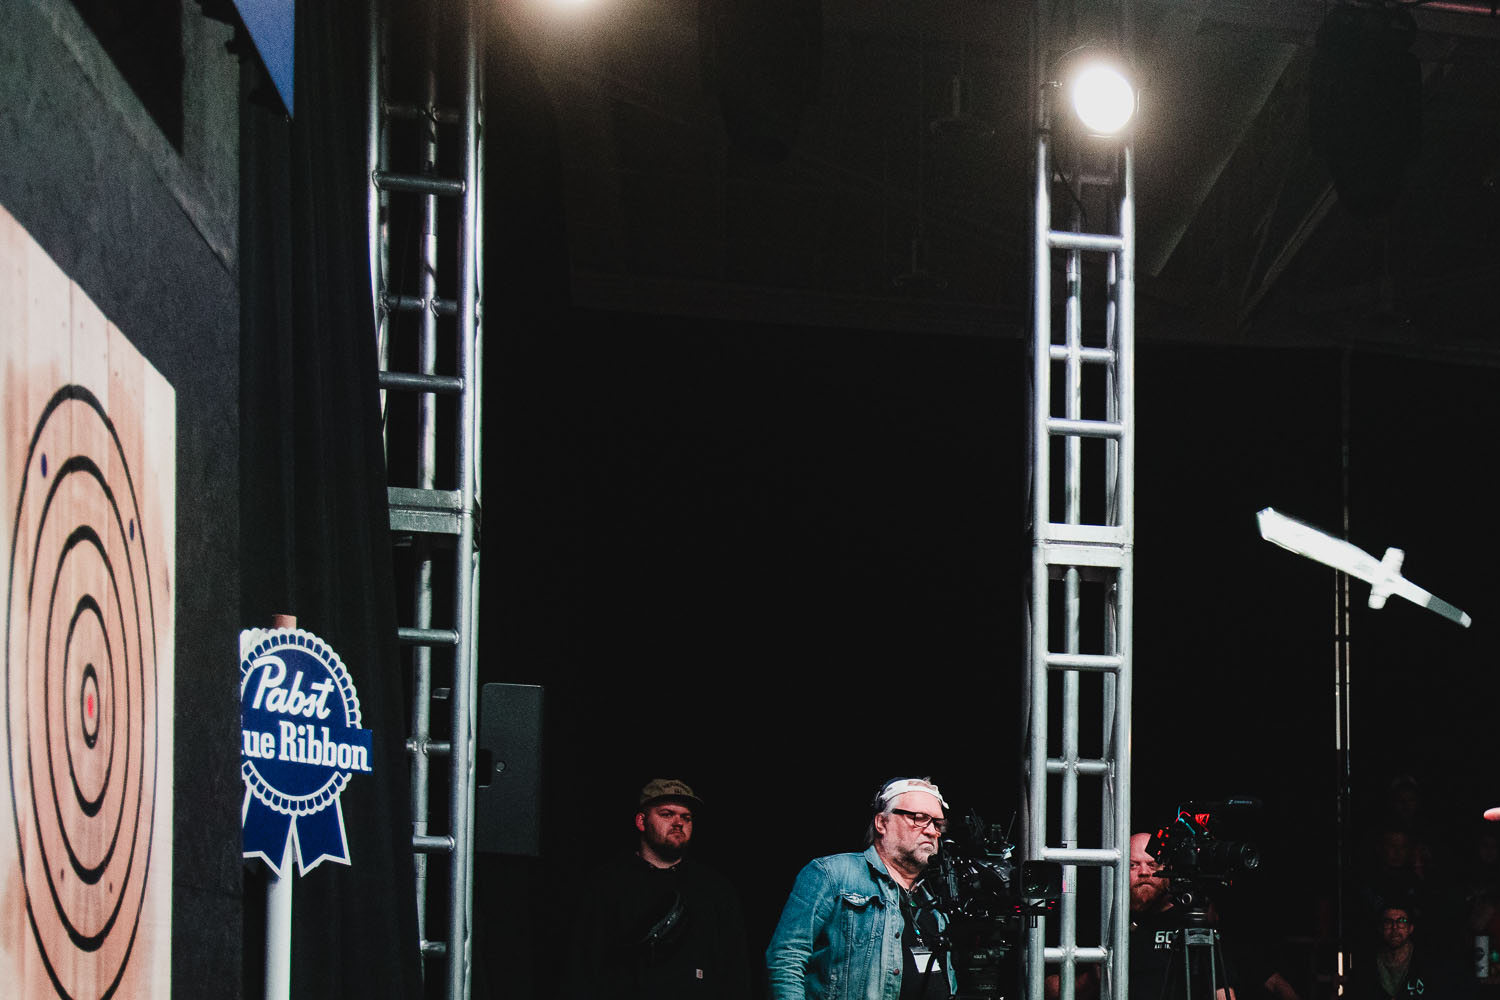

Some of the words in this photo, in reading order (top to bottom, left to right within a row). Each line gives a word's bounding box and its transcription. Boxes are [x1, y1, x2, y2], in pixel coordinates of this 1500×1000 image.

[252, 655, 335, 720] Pabst
[241, 729, 276, 760] ue
[278, 719, 371, 772] Ribbon
